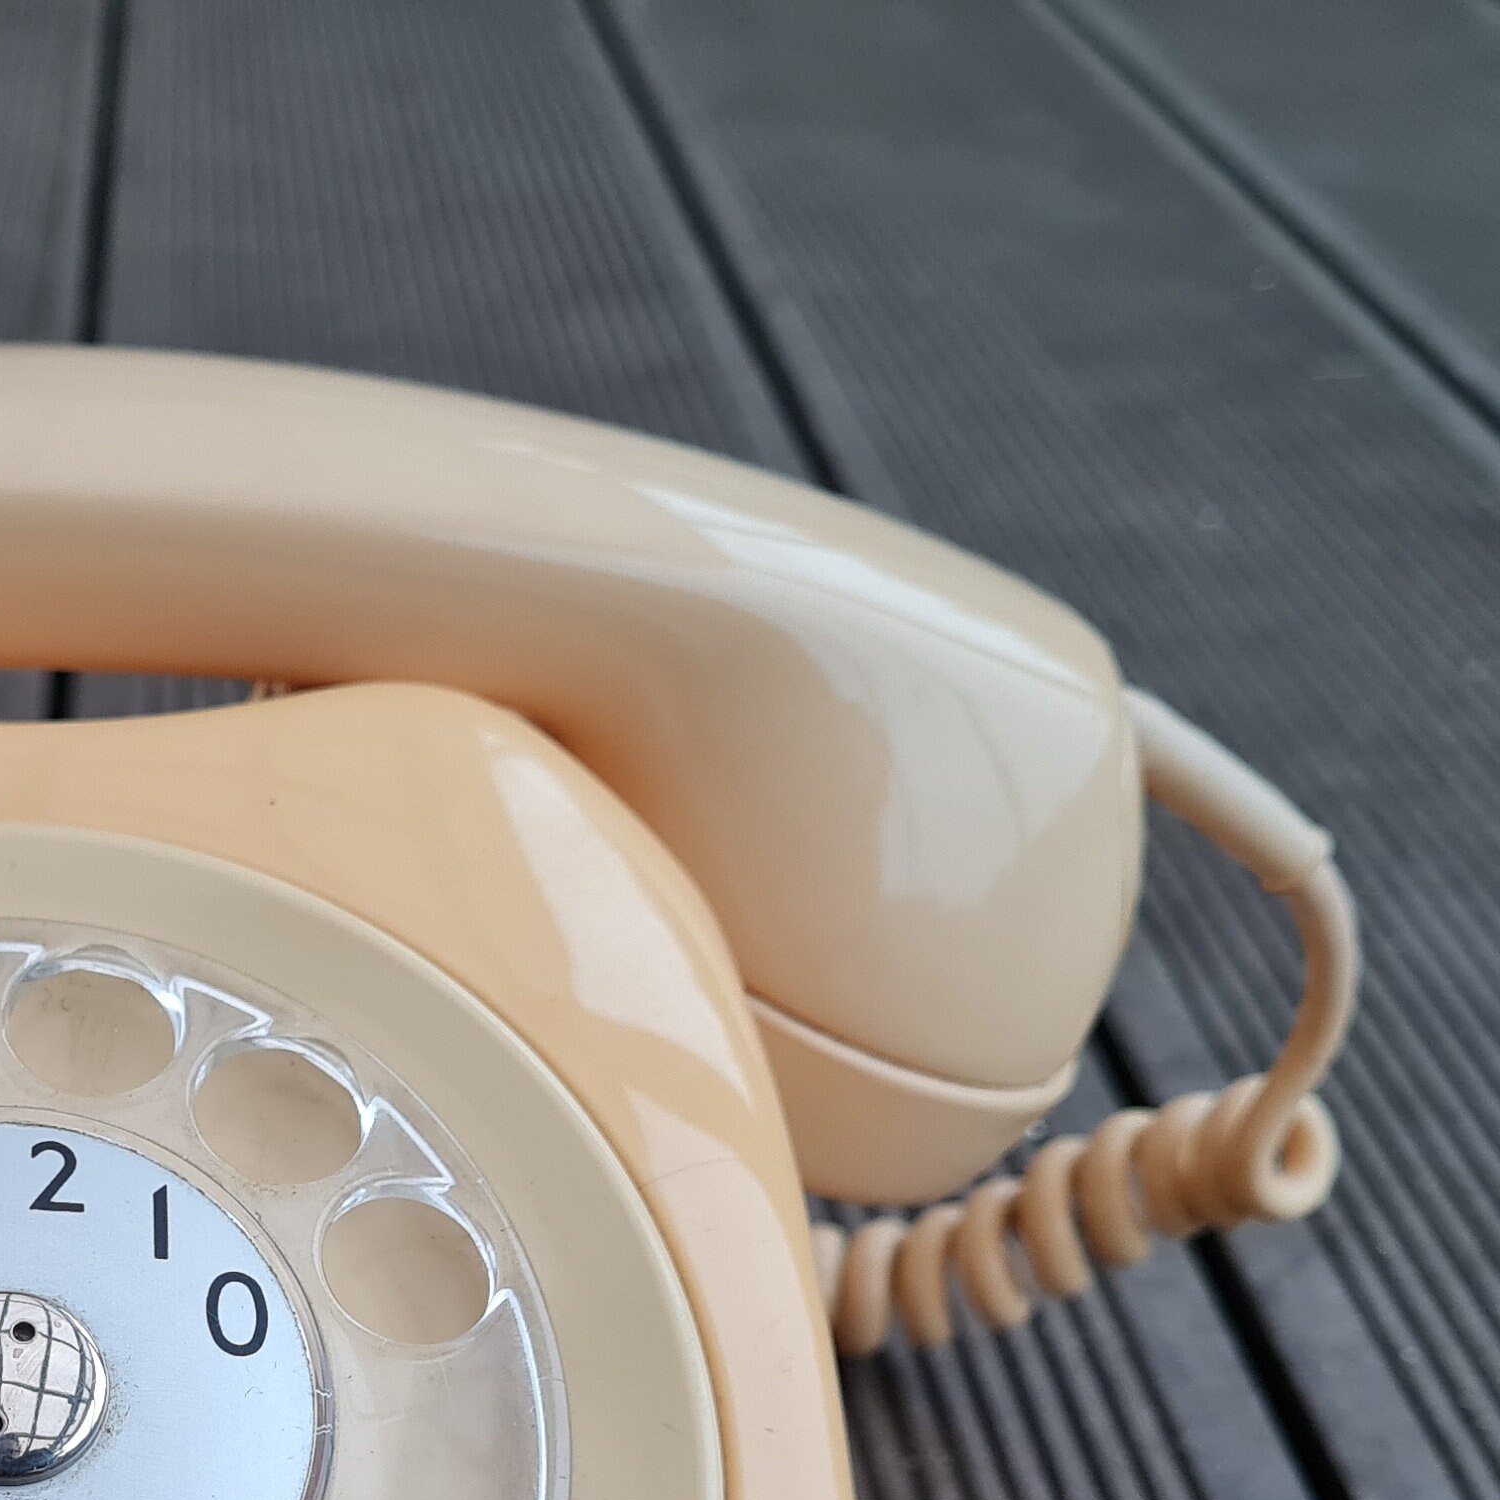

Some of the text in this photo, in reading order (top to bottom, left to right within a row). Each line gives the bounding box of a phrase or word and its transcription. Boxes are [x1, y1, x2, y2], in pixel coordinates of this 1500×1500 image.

[29, 1140, 85, 1213] 2
[152, 1184, 168, 1260] 1
[206, 1271, 269, 1357] 0
